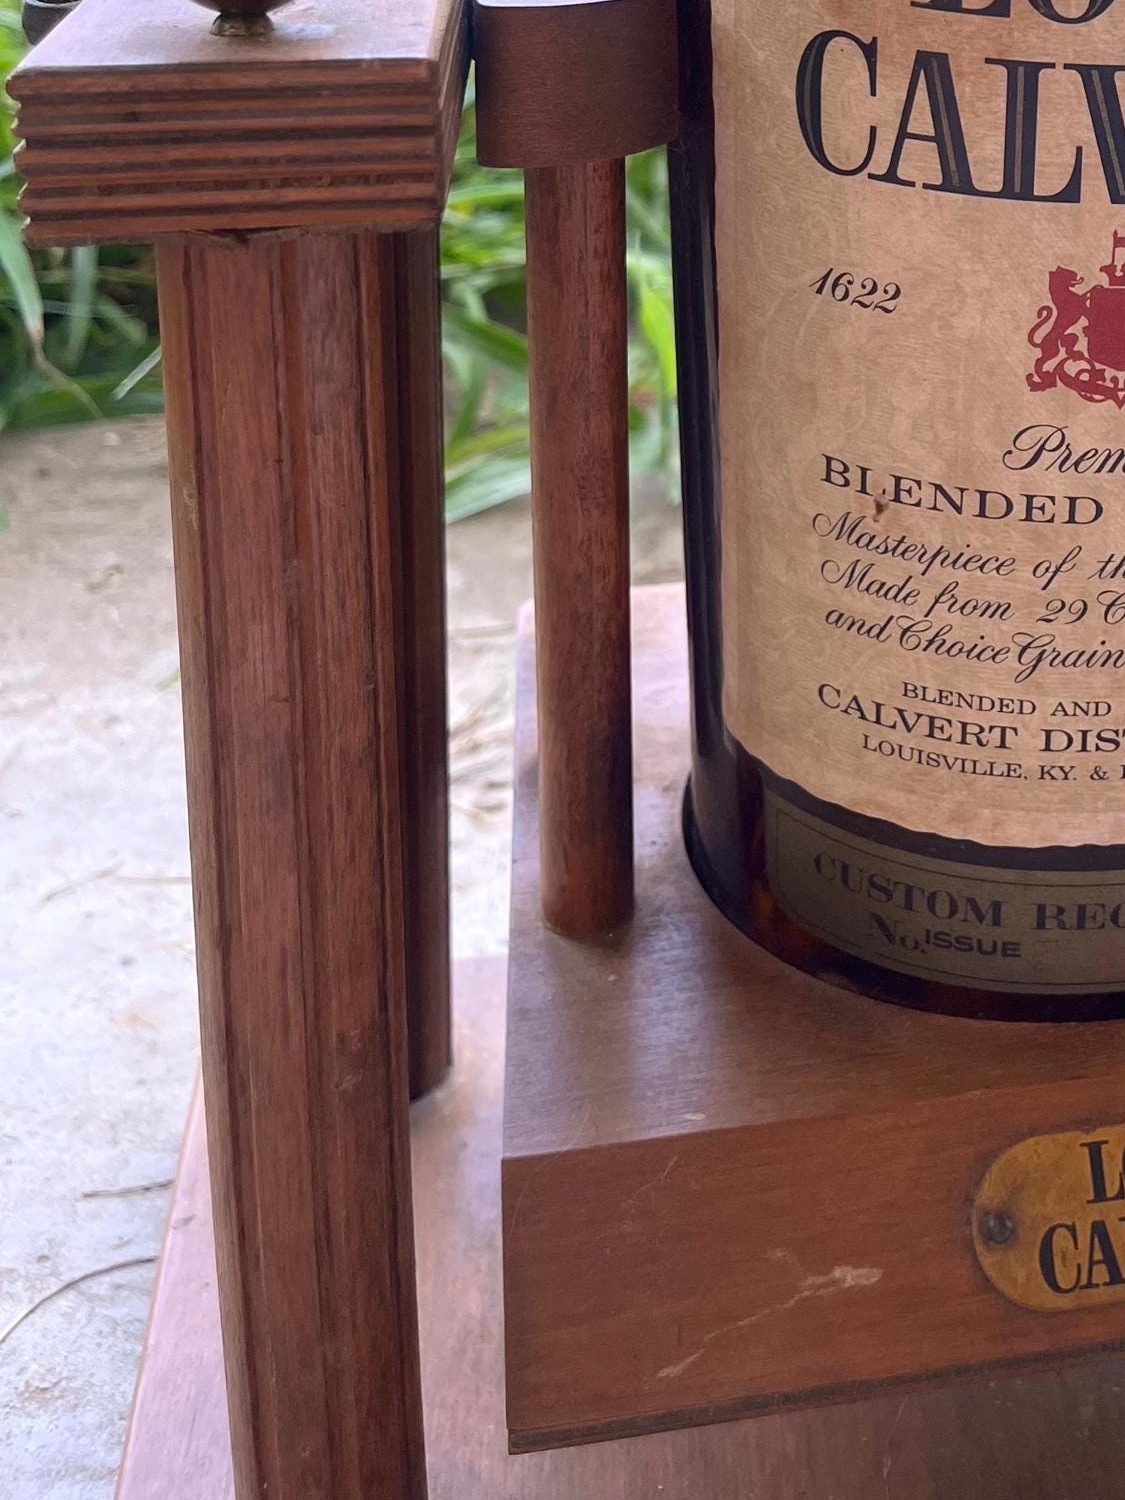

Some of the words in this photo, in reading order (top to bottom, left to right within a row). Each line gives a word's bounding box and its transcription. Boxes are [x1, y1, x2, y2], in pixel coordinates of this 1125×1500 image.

[808, 266, 902, 314] 1622
[820, 452, 1104, 526] BLENDED
[812, 511, 1017, 577] Masterpiece
[1032, 545, 1083, 591] of
[820, 558, 921, 606] Made
[924, 580, 1016, 621] from
[1035, 598, 1089, 625] 29
[825, 608, 898, 643] and
[896, 615, 1011, 664] Choice
[817, 682, 1019, 750] CALVERT
[901, 680, 1037, 716] BLENDED
[1050, 700, 1112, 717] AND
[862, 733, 1028, 781] LOUISVILLE,
[1037, 763, 1078, 781] KY.
[1089, 765, 1109, 781] &
[812, 851, 1008, 929] CUSTOM
[869, 910, 927, 955] No.
[924, 928, 1022, 959] ISSUE
